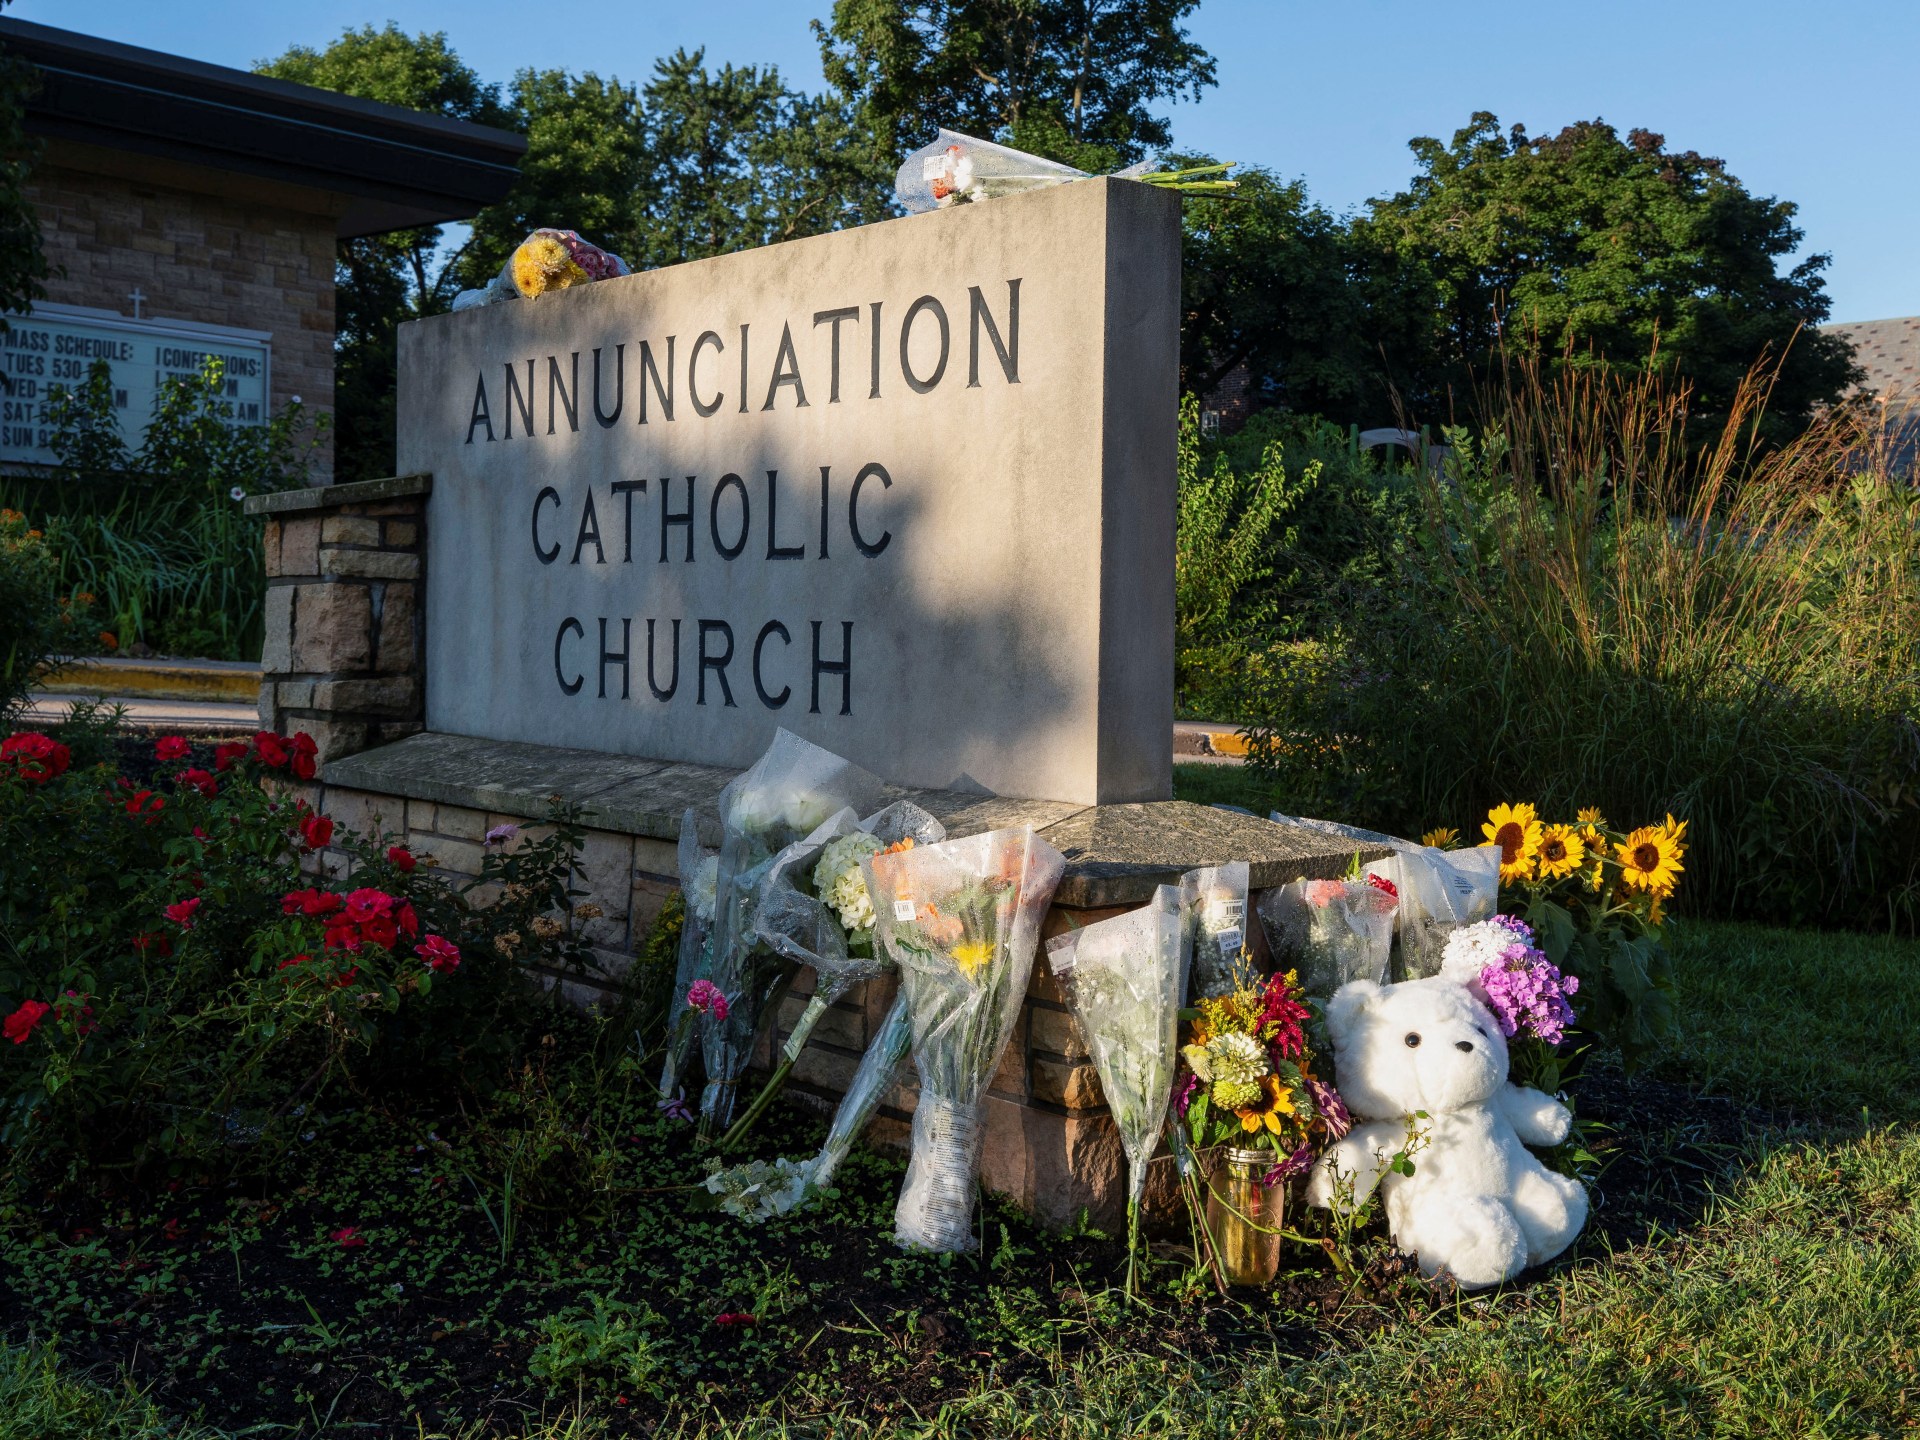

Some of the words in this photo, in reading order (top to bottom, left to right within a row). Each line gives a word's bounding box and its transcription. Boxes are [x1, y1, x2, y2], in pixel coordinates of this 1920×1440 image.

[5, 328, 49, 351] MASS
[55, 334, 133, 361] SCHEDULE:
[5, 352, 44, 375] TUES
[53, 358, 81, 380] 530
[163, 347, 261, 377] CONFEIONS:
[464, 278, 1023, 445] ANNUNCIATION
[3, 401, 33, 423] SAT
[238, 402, 259, 421] AM
[2, 426, 33, 447] SUN
[531, 462, 893, 566] CATHOLIC
[554, 616, 855, 716] CHURCH
